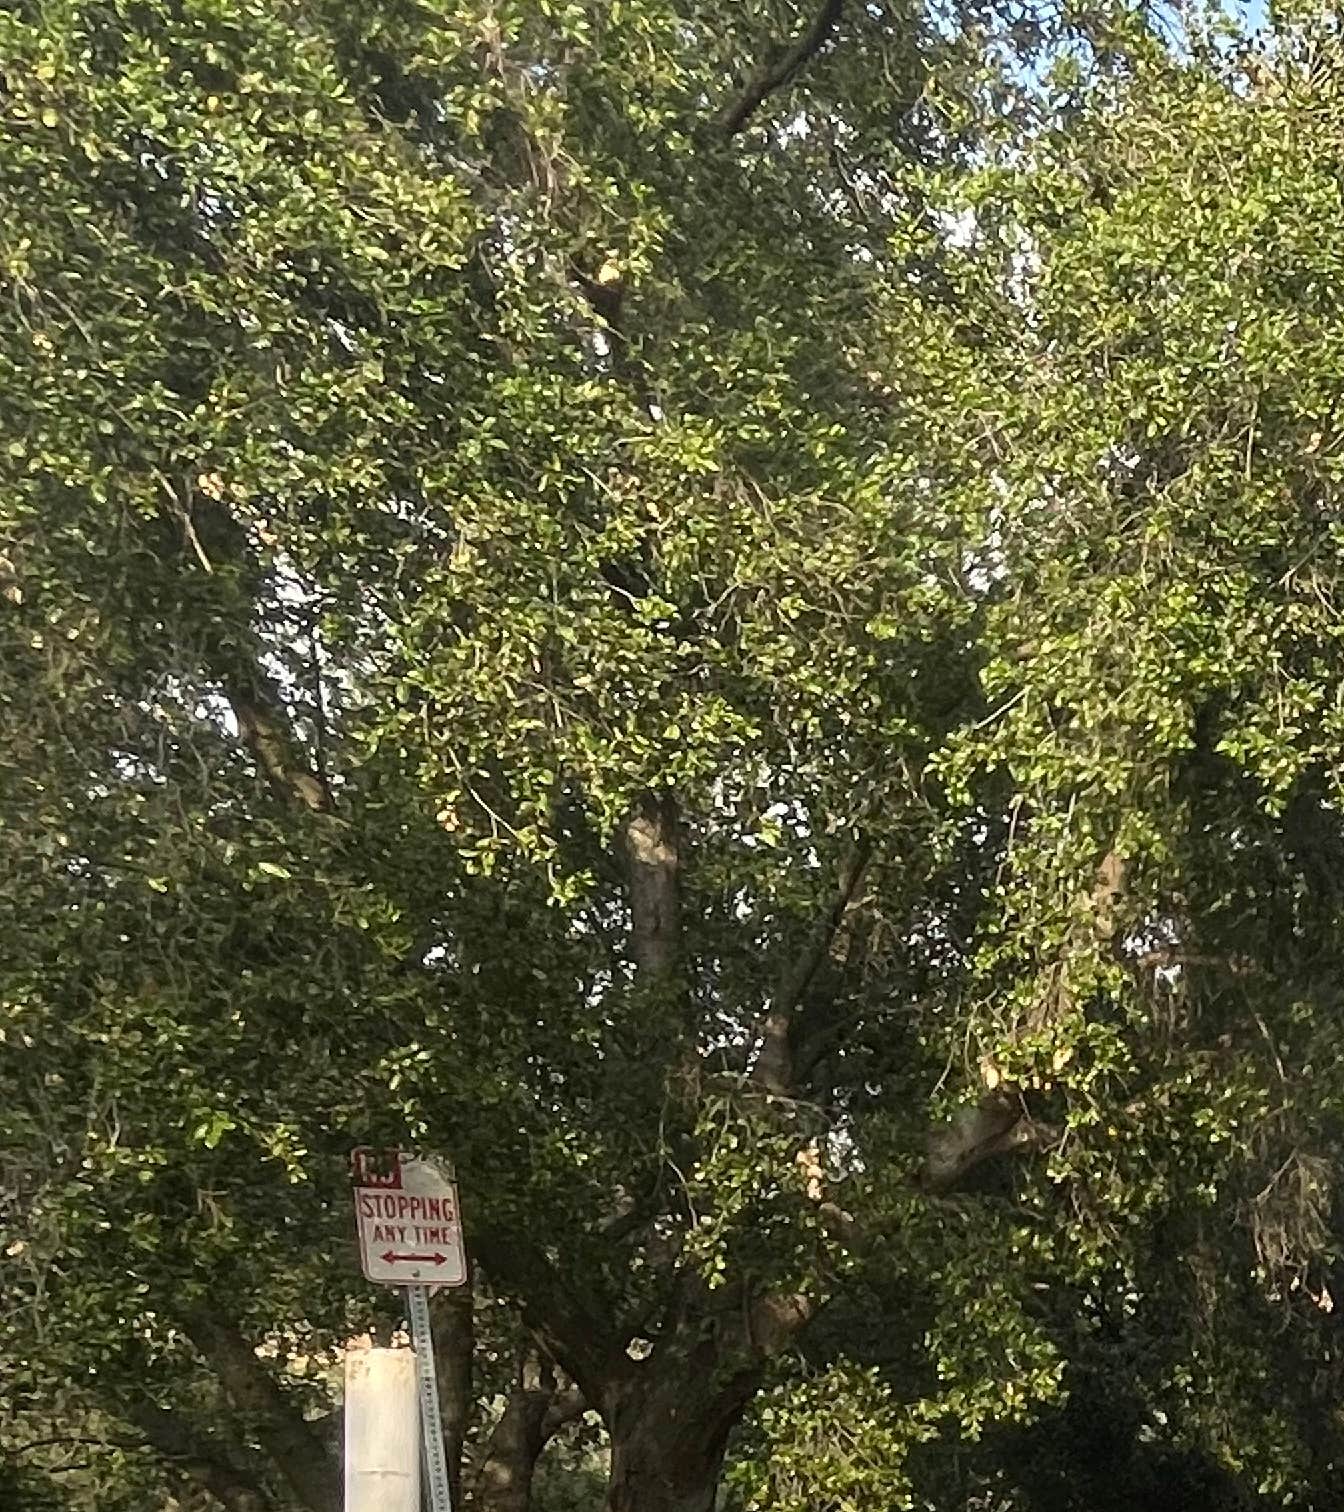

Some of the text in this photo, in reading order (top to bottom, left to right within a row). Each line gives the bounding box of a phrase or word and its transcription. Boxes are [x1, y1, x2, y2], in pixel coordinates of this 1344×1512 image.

[359, 1153, 395, 1184] N
[360, 1194, 454, 1222] STOPPING
[373, 1224, 452, 1246] ANY TIME
